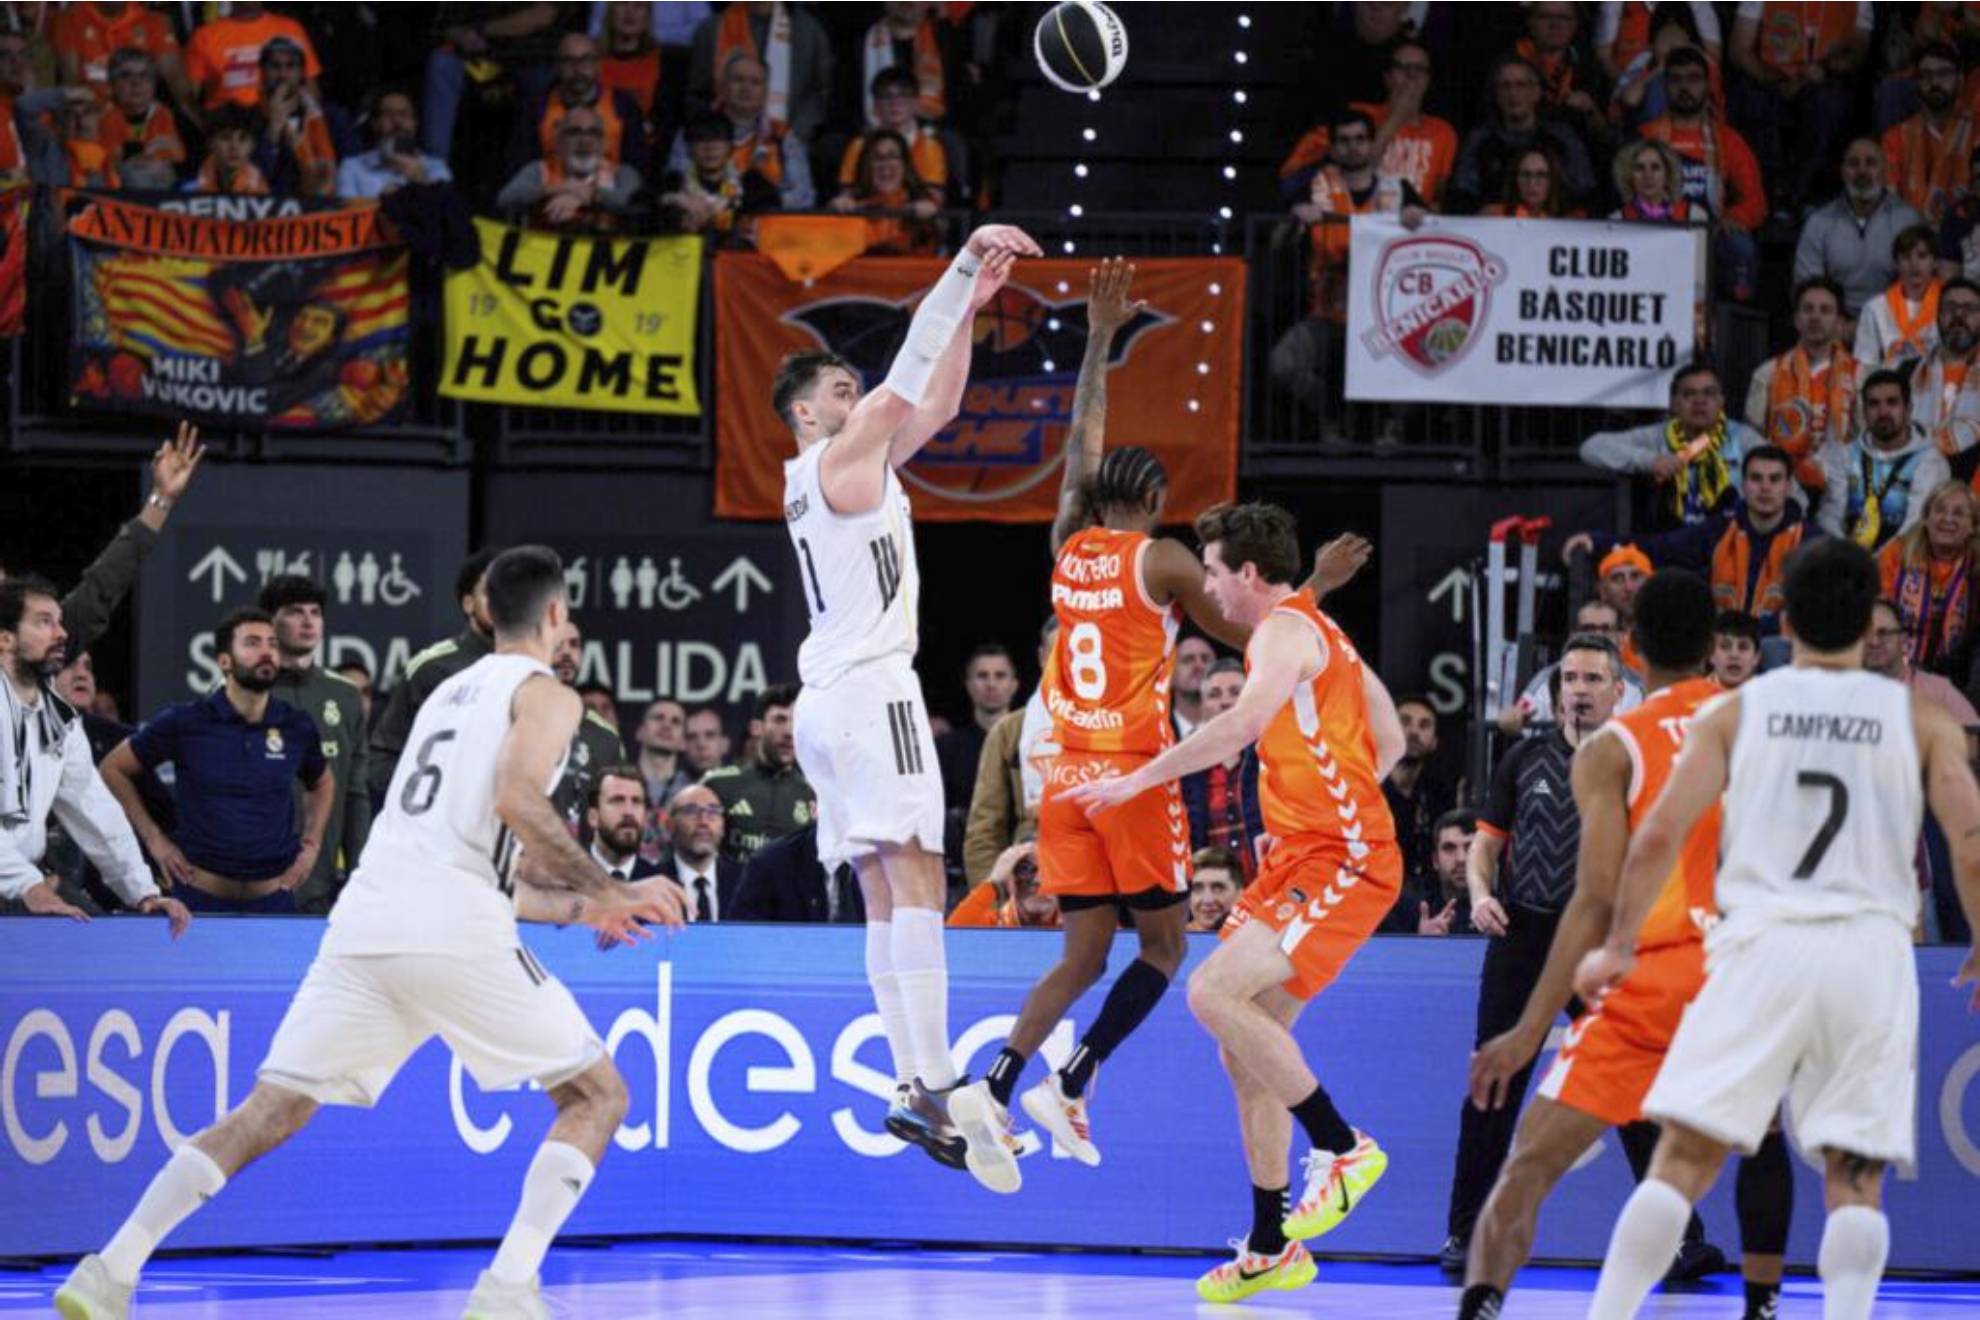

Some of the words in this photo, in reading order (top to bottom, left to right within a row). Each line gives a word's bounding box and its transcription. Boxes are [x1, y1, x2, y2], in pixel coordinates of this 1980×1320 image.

[496, 229, 651, 296] LIM
[1398, 272, 1433, 297] CB
[1549, 246, 1629, 279] CLUB
[141, 373, 268, 413] VUKOVIC
[151, 356, 222, 383] MIKI
[452, 335, 683, 400] HOME
[574, 640, 769, 702] ALIDA
[1069, 622, 1107, 700] 8
[1767, 713, 1883, 746] CAMPAZZO
[400, 728, 457, 816] 6
[1791, 769, 1849, 881] 7
[450, 961, 1075, 1158] desa
